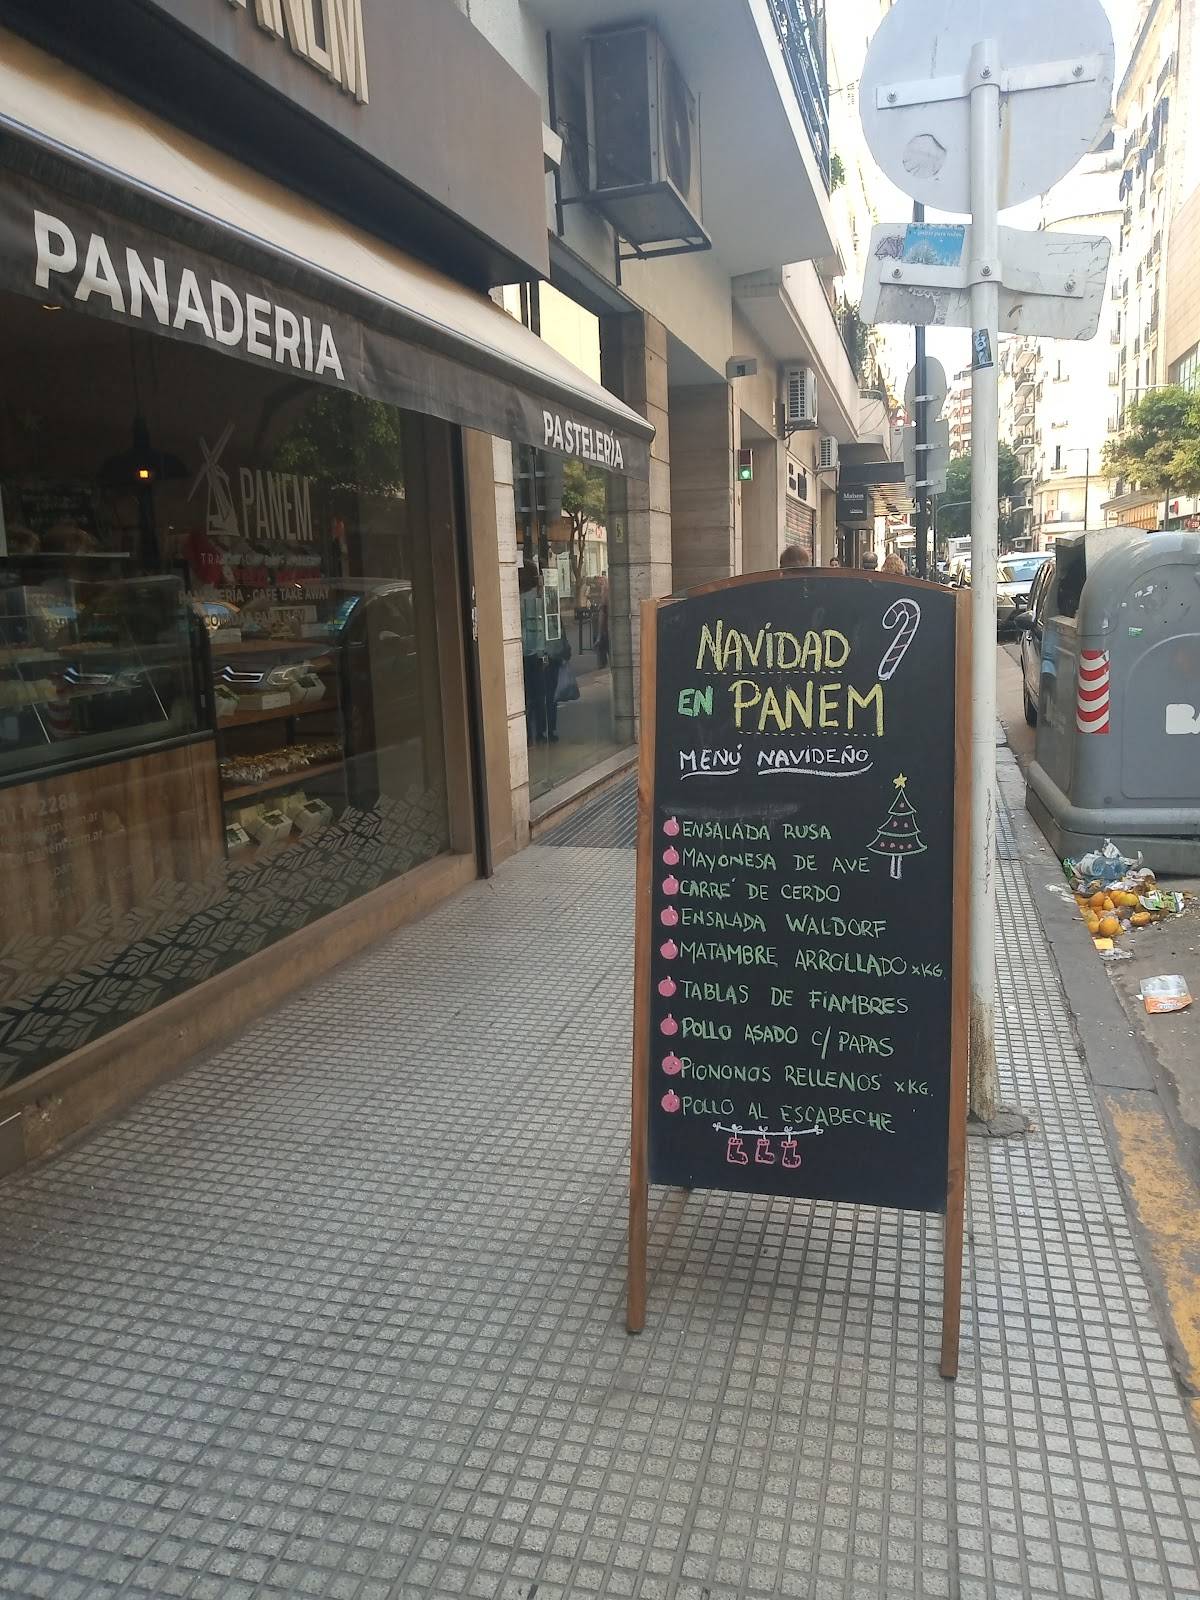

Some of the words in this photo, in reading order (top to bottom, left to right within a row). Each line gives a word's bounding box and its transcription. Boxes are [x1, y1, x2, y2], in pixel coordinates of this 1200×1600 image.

[34, 210, 345, 380] PANADERIA
[543, 409, 624, 470] PASTELERÍA
[239, 467, 313, 541] PANEM
[281, 587, 304, 601] TAKE
[305, 586, 330, 601] AWAY
[677, 686, 714, 717] EN
[728, 680, 884, 737] PANEM
[680, 744, 743, 771] MENÚ
[682, 820, 771, 841] ENSALADA
[783, 823, 832, 841] RUSA
[682, 847, 777, 873] MAYONESA
[794, 854, 818, 872] DE
[832, 856, 871, 874] AVE
[679, 877, 736, 899] CARRÉ
[745, 883, 769, 900] DE
[781, 884, 840, 903] CERDO
[682, 908, 767, 932] ENSALADA
[785, 913, 887, 938] WALDORF
[679, 941, 778, 967] MATAMBRE
[795, 949, 907, 977] ARROLLADO
[679, 979, 750, 1004] TABLAS
[771, 986, 794, 1006] DE
[682, 1017, 732, 1041] POLLO
[744, 1023, 798, 1045] ASADO
[839, 1031, 895, 1057] PAPAS
[785, 1065, 882, 1092] RELLENOS
[682, 1097, 734, 1115] POLLO
[748, 1103, 768, 1120] AL
[780, 1104, 896, 1134] ESCABECHE
